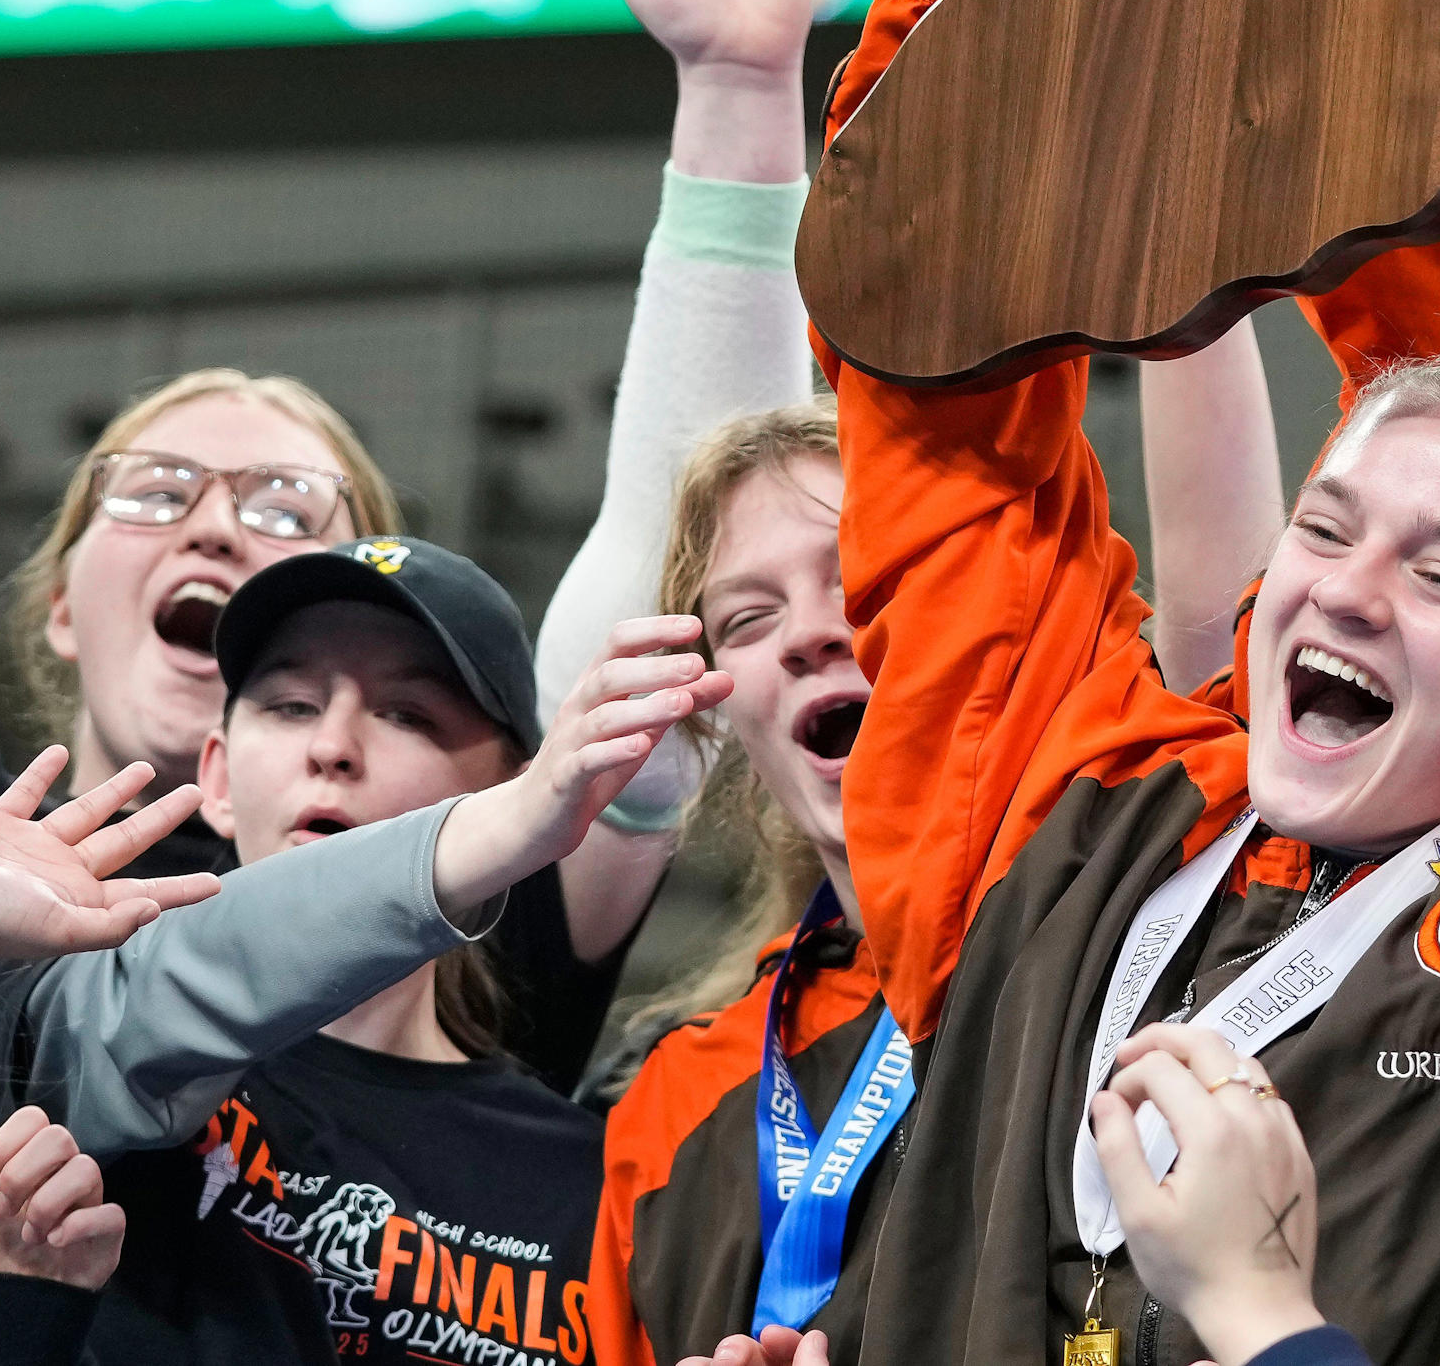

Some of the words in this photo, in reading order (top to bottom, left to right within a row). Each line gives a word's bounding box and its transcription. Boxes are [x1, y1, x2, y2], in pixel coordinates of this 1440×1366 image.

[1221, 949, 1334, 1037] PLACE
[811, 1028, 914, 1197] CHAMPION
[373, 1214, 589, 1366] FINALS
[415, 1210, 467, 1244] HIGH
[469, 1231, 554, 1262] SCHOOL
